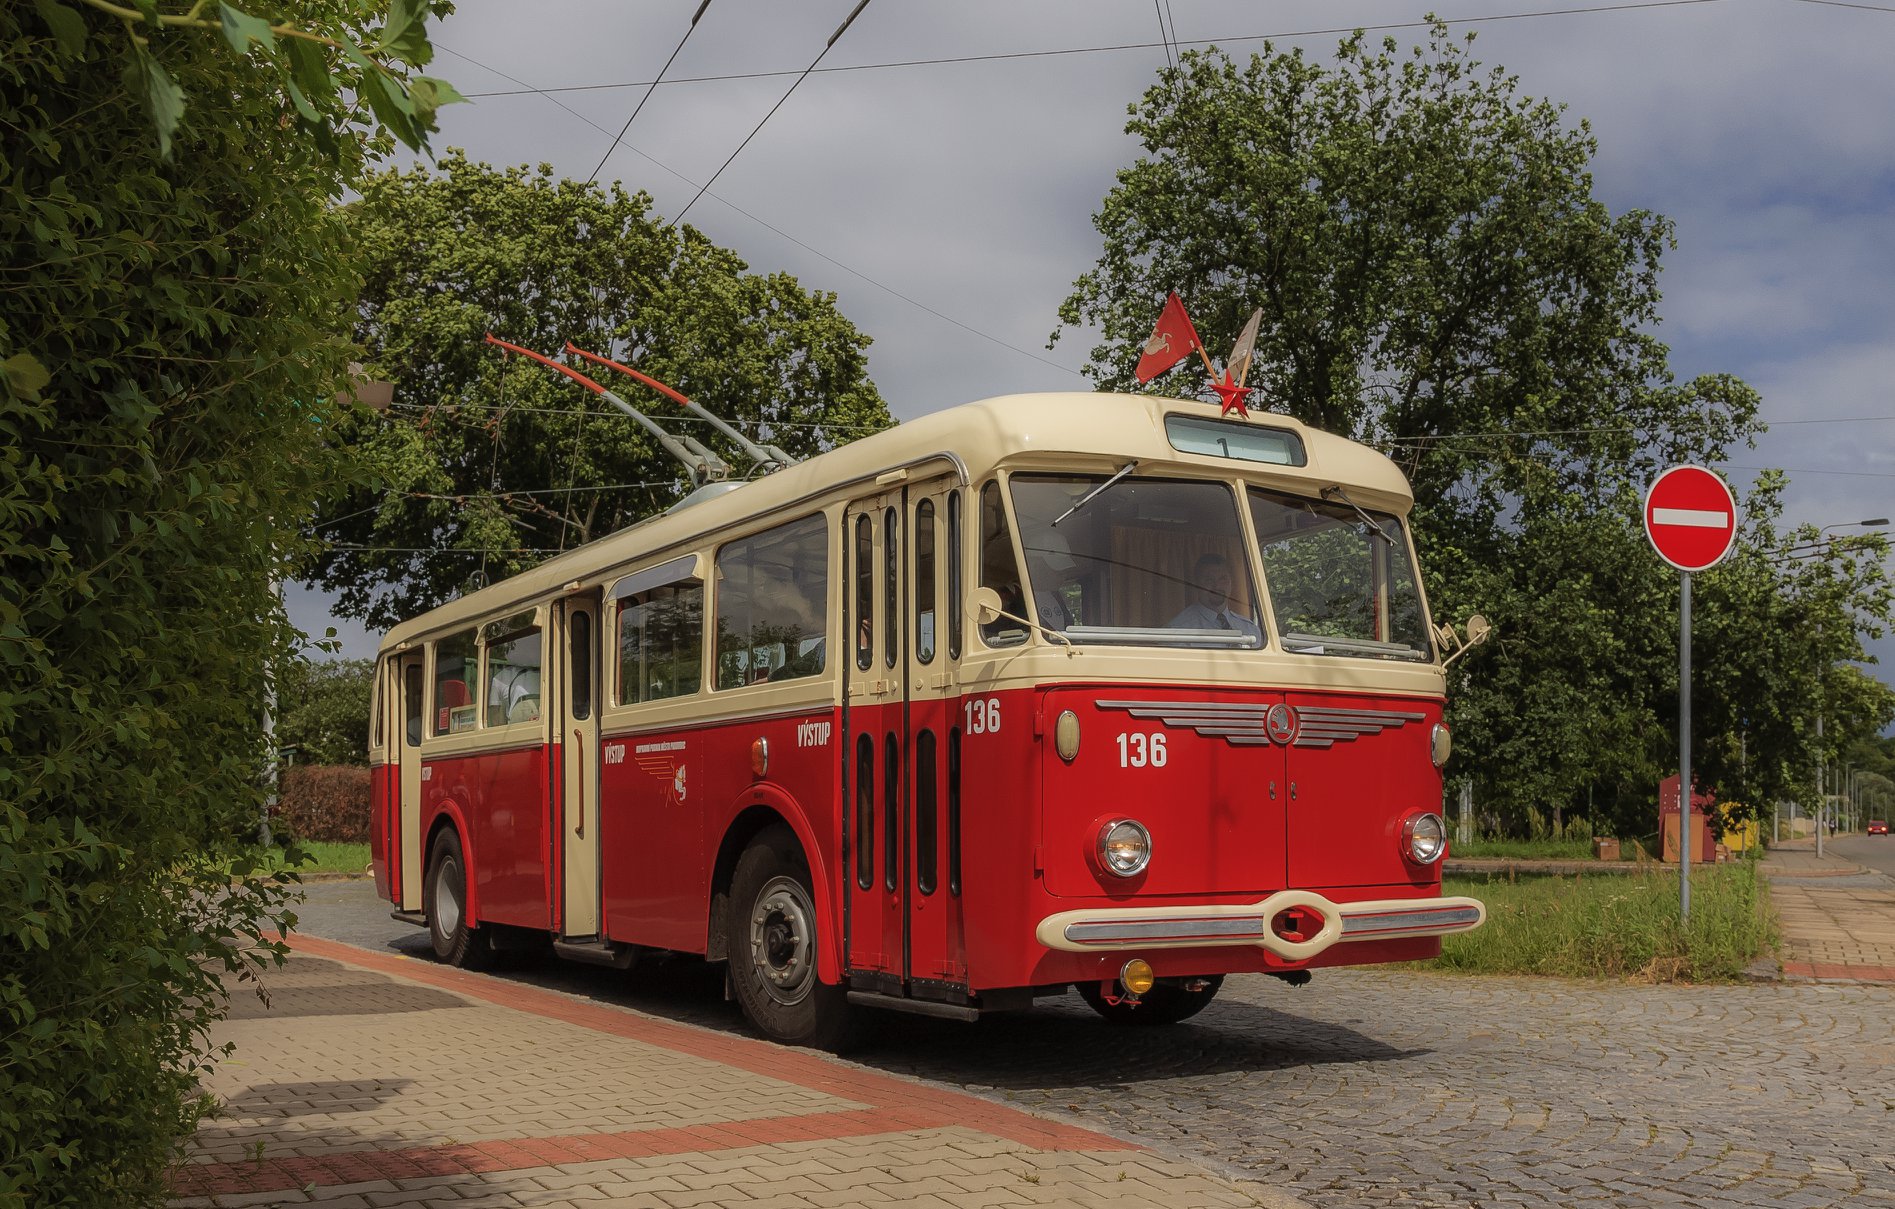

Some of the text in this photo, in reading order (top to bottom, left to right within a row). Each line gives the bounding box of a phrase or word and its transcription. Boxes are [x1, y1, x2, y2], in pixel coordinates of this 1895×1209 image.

[797, 719, 831, 747] VÝSTUP
[965, 698, 1000, 734] 136
[1116, 732, 1167, 768] 136
